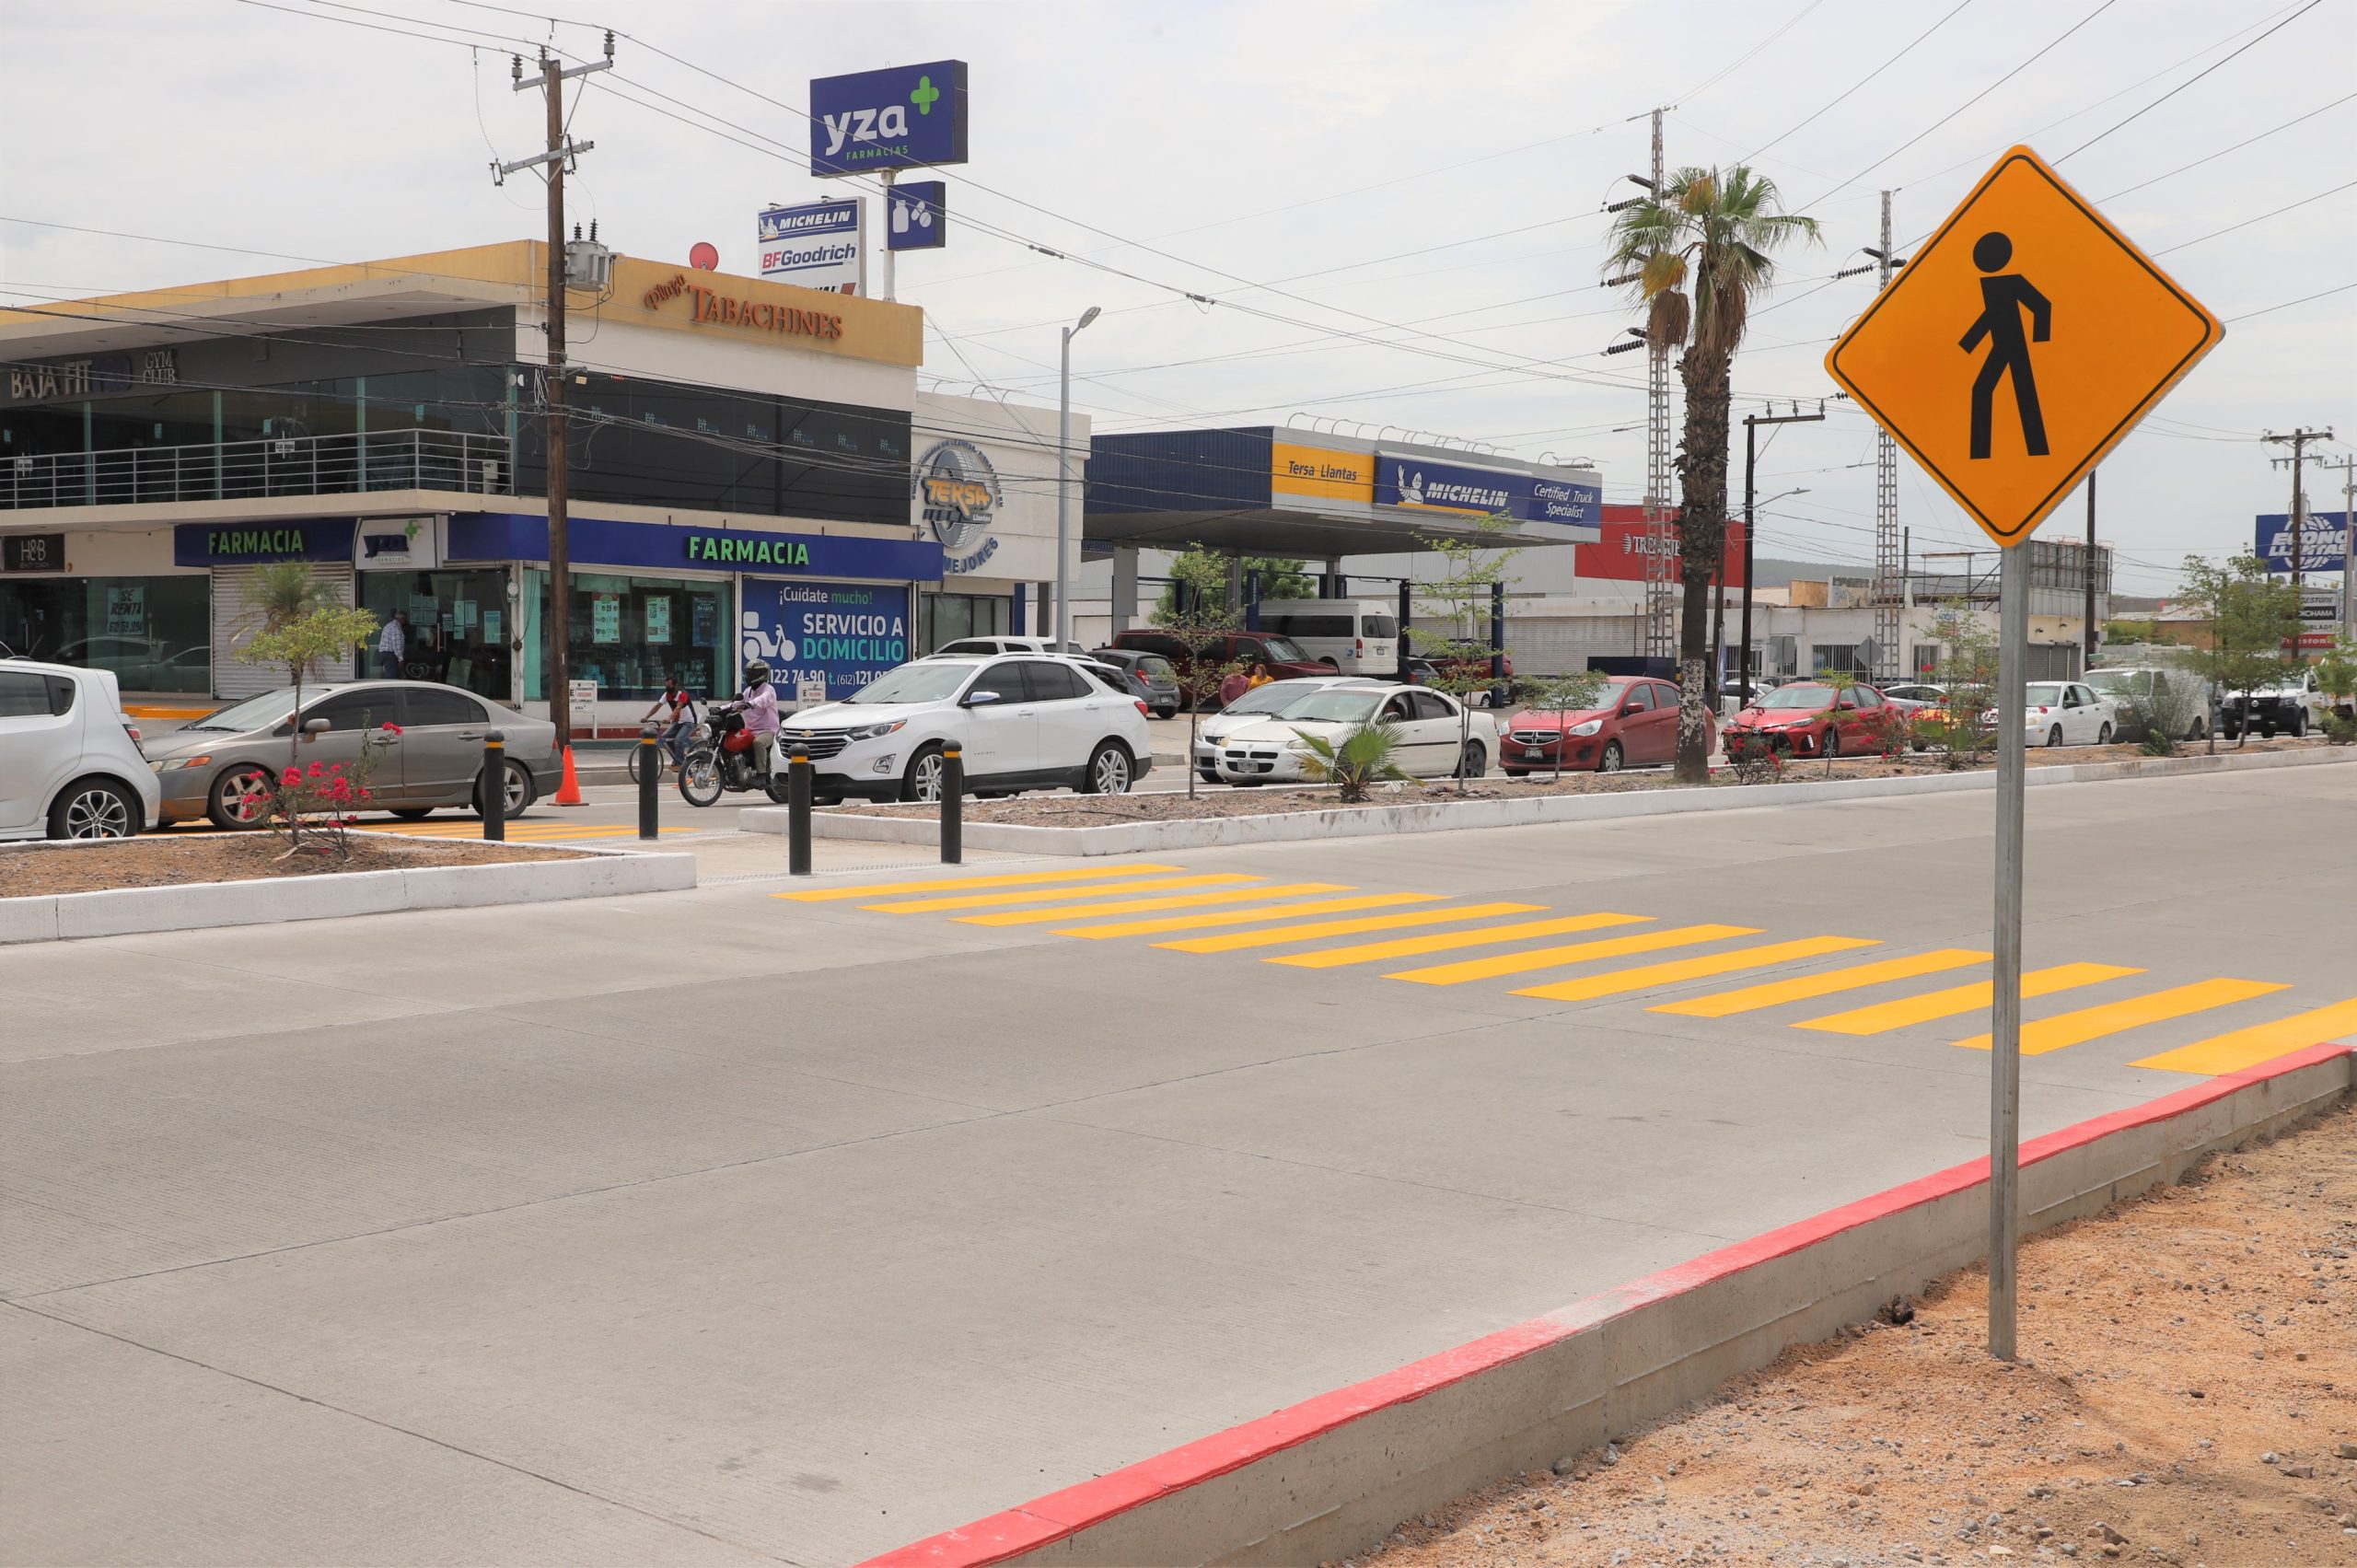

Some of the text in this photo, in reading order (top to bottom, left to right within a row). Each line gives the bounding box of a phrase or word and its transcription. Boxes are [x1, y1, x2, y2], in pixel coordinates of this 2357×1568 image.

[823, 105, 908, 157] yza
[846, 145, 909, 161] FARMACIAS
[779, 211, 851, 230] MICHELIN
[762, 243, 856, 269] BFGoodrich
[690, 285, 843, 340] TABACHINES
[145, 351, 175, 369] GYM
[10, 367, 58, 400] BAJA
[64, 359, 93, 395] FIT
[142, 367, 176, 385] CLUB
[1289, 460, 1357, 482] Tersa Llantas
[926, 479, 992, 517] TERSA
[1426, 482, 1509, 506] MICHELIN
[1534, 483, 1594, 504] Certified Truck
[1545, 502, 1585, 519] Specialist
[20, 540, 46, 562] H&B
[208, 529, 304, 554] FARMACIA
[689, 536, 810, 565] FARMACIA
[121, 589, 135, 602] SE
[779, 587, 873, 606] ¡Cuídate mucho!
[803, 612, 904, 637] SERVICIO A
[803, 637, 904, 662] DOMICILIO
[768, 668, 789, 684] 122
